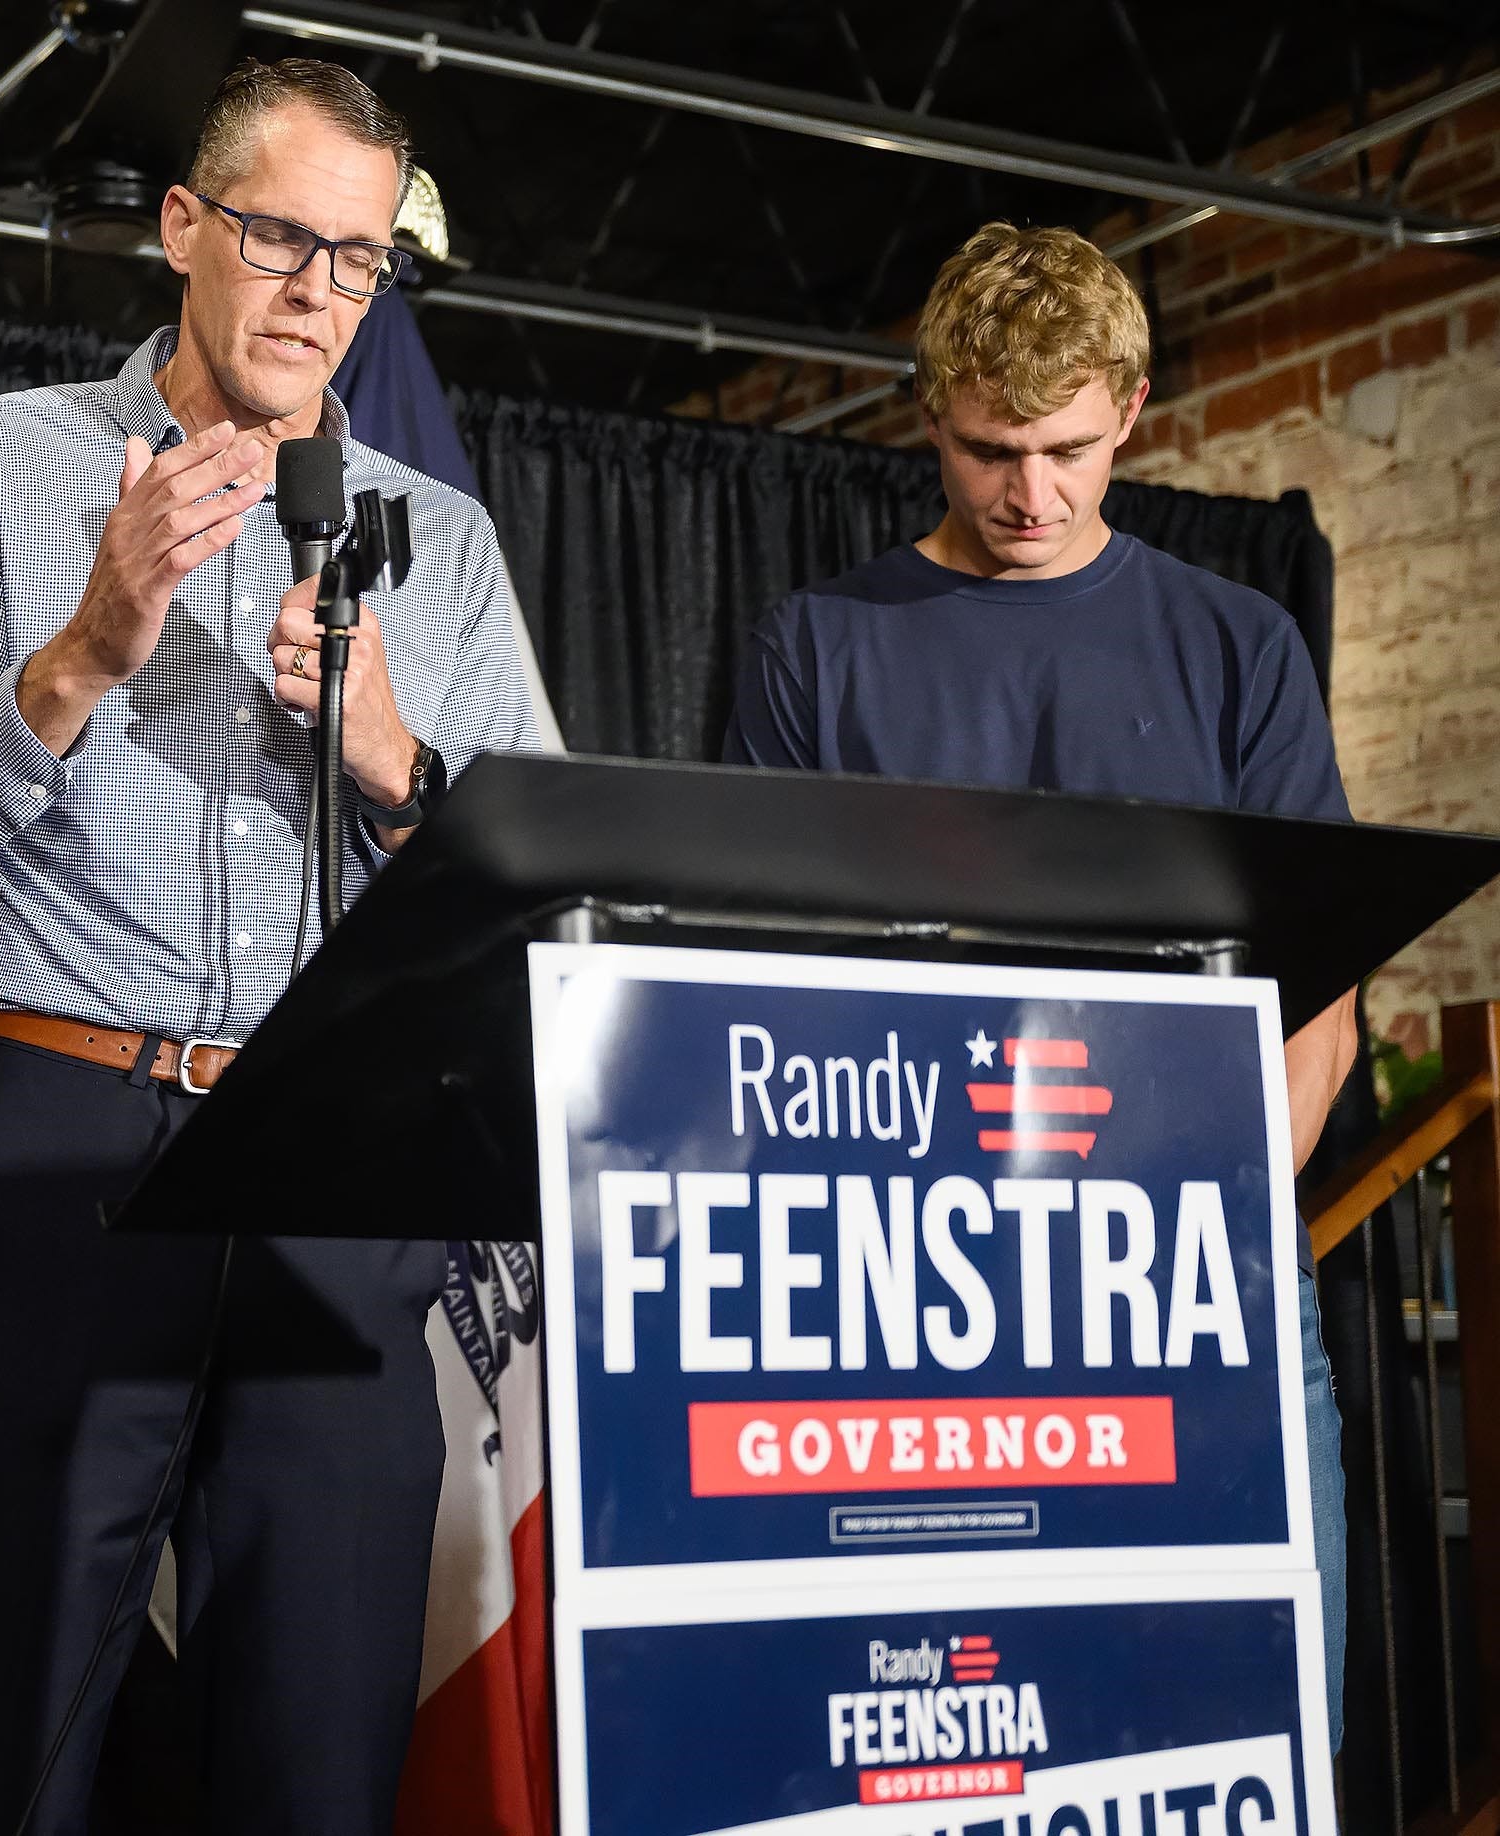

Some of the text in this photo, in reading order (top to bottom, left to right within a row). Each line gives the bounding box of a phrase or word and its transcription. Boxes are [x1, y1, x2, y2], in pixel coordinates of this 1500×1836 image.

[728, 1022, 940, 1159] Randy
[597, 1169, 1250, 1374] FEENSTRA
[737, 1413, 1128, 1476] GOVERNOR
[869, 1638, 944, 1687] Randy
[829, 1682, 1049, 1768] FEENSTRA
[874, 1767, 1010, 1800] GOVERNOR
